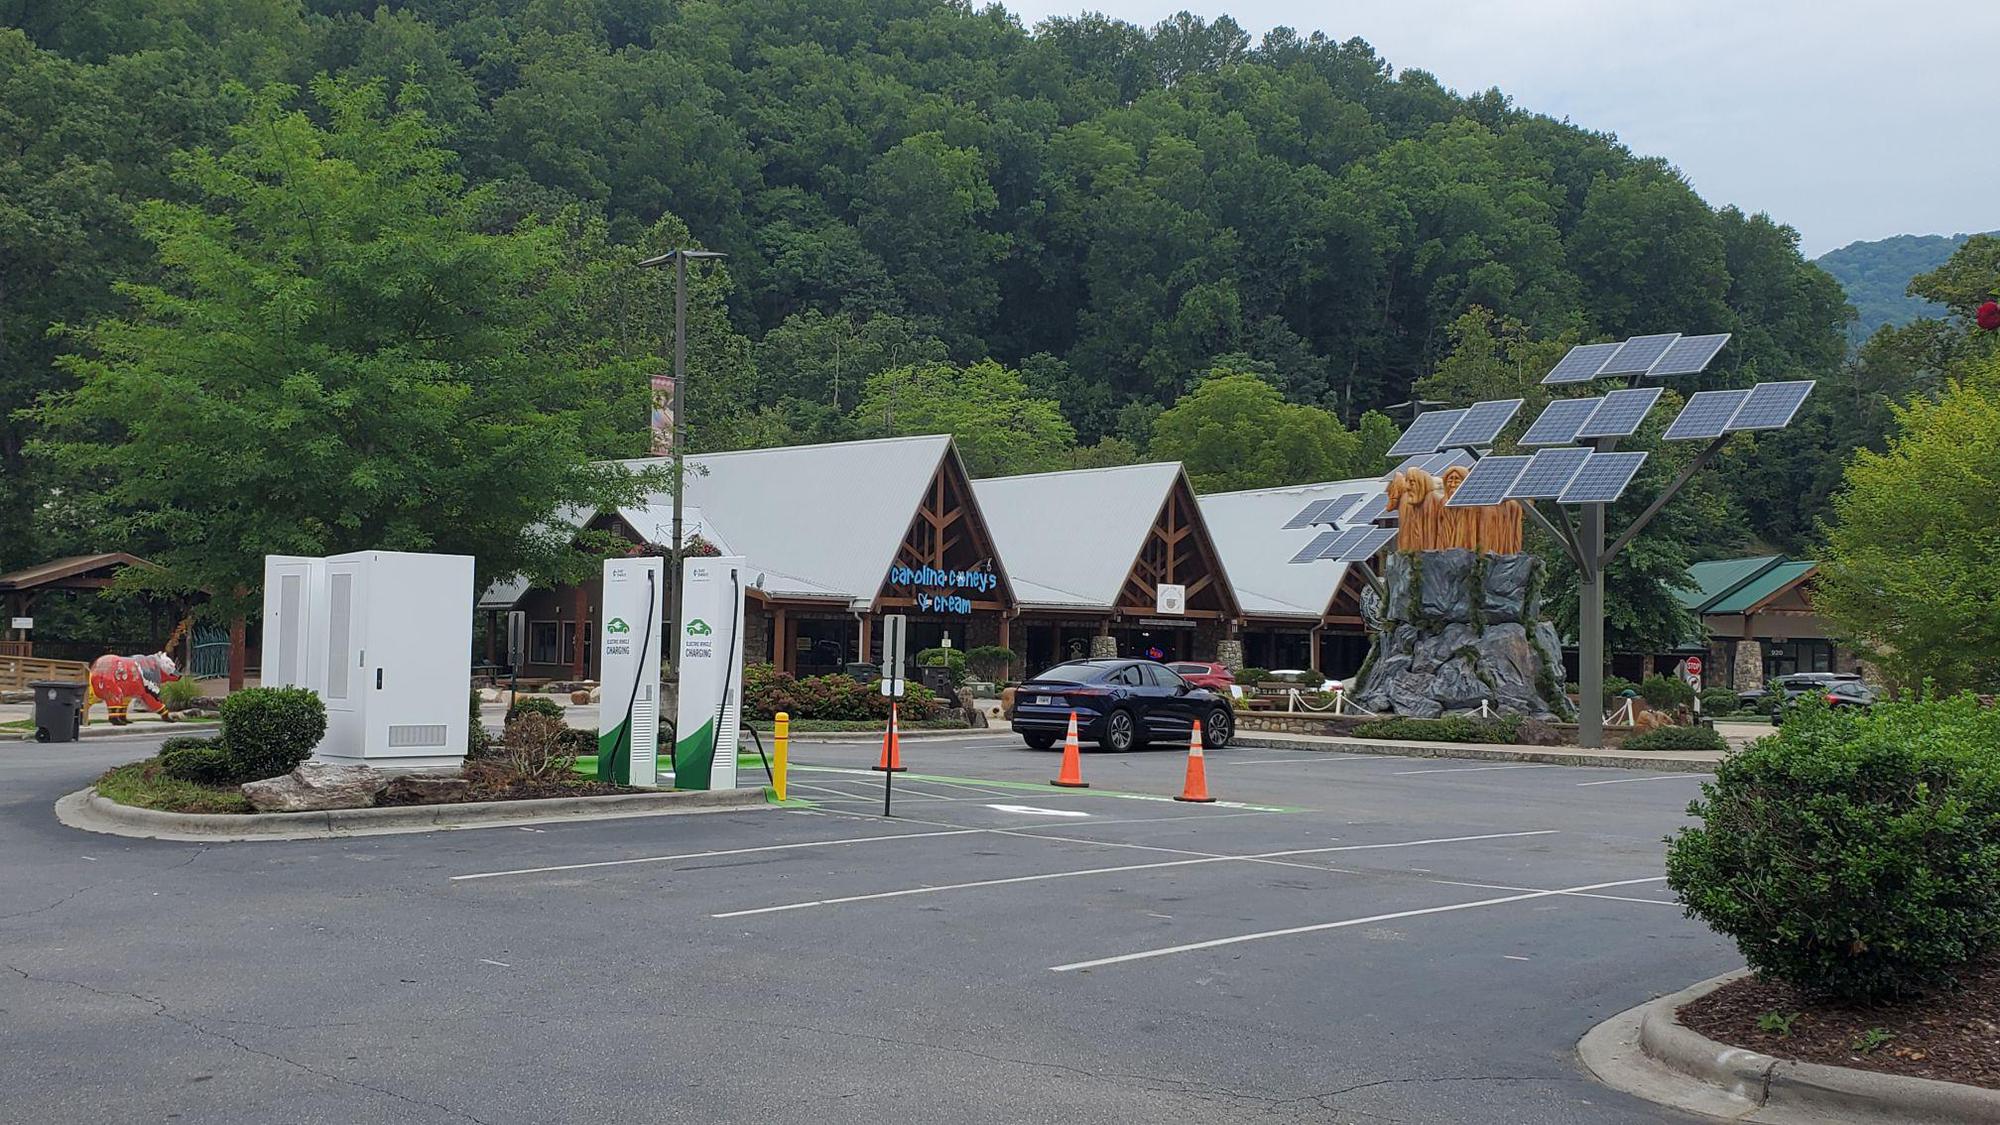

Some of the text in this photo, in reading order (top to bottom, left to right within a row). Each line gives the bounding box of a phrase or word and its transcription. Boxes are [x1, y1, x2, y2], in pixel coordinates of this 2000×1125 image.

[933, 595, 972, 614] cream
[606, 646, 630, 655] CHARGING
[685, 648, 712, 658] CHARGING
[1687, 662, 1700, 671] STOP
